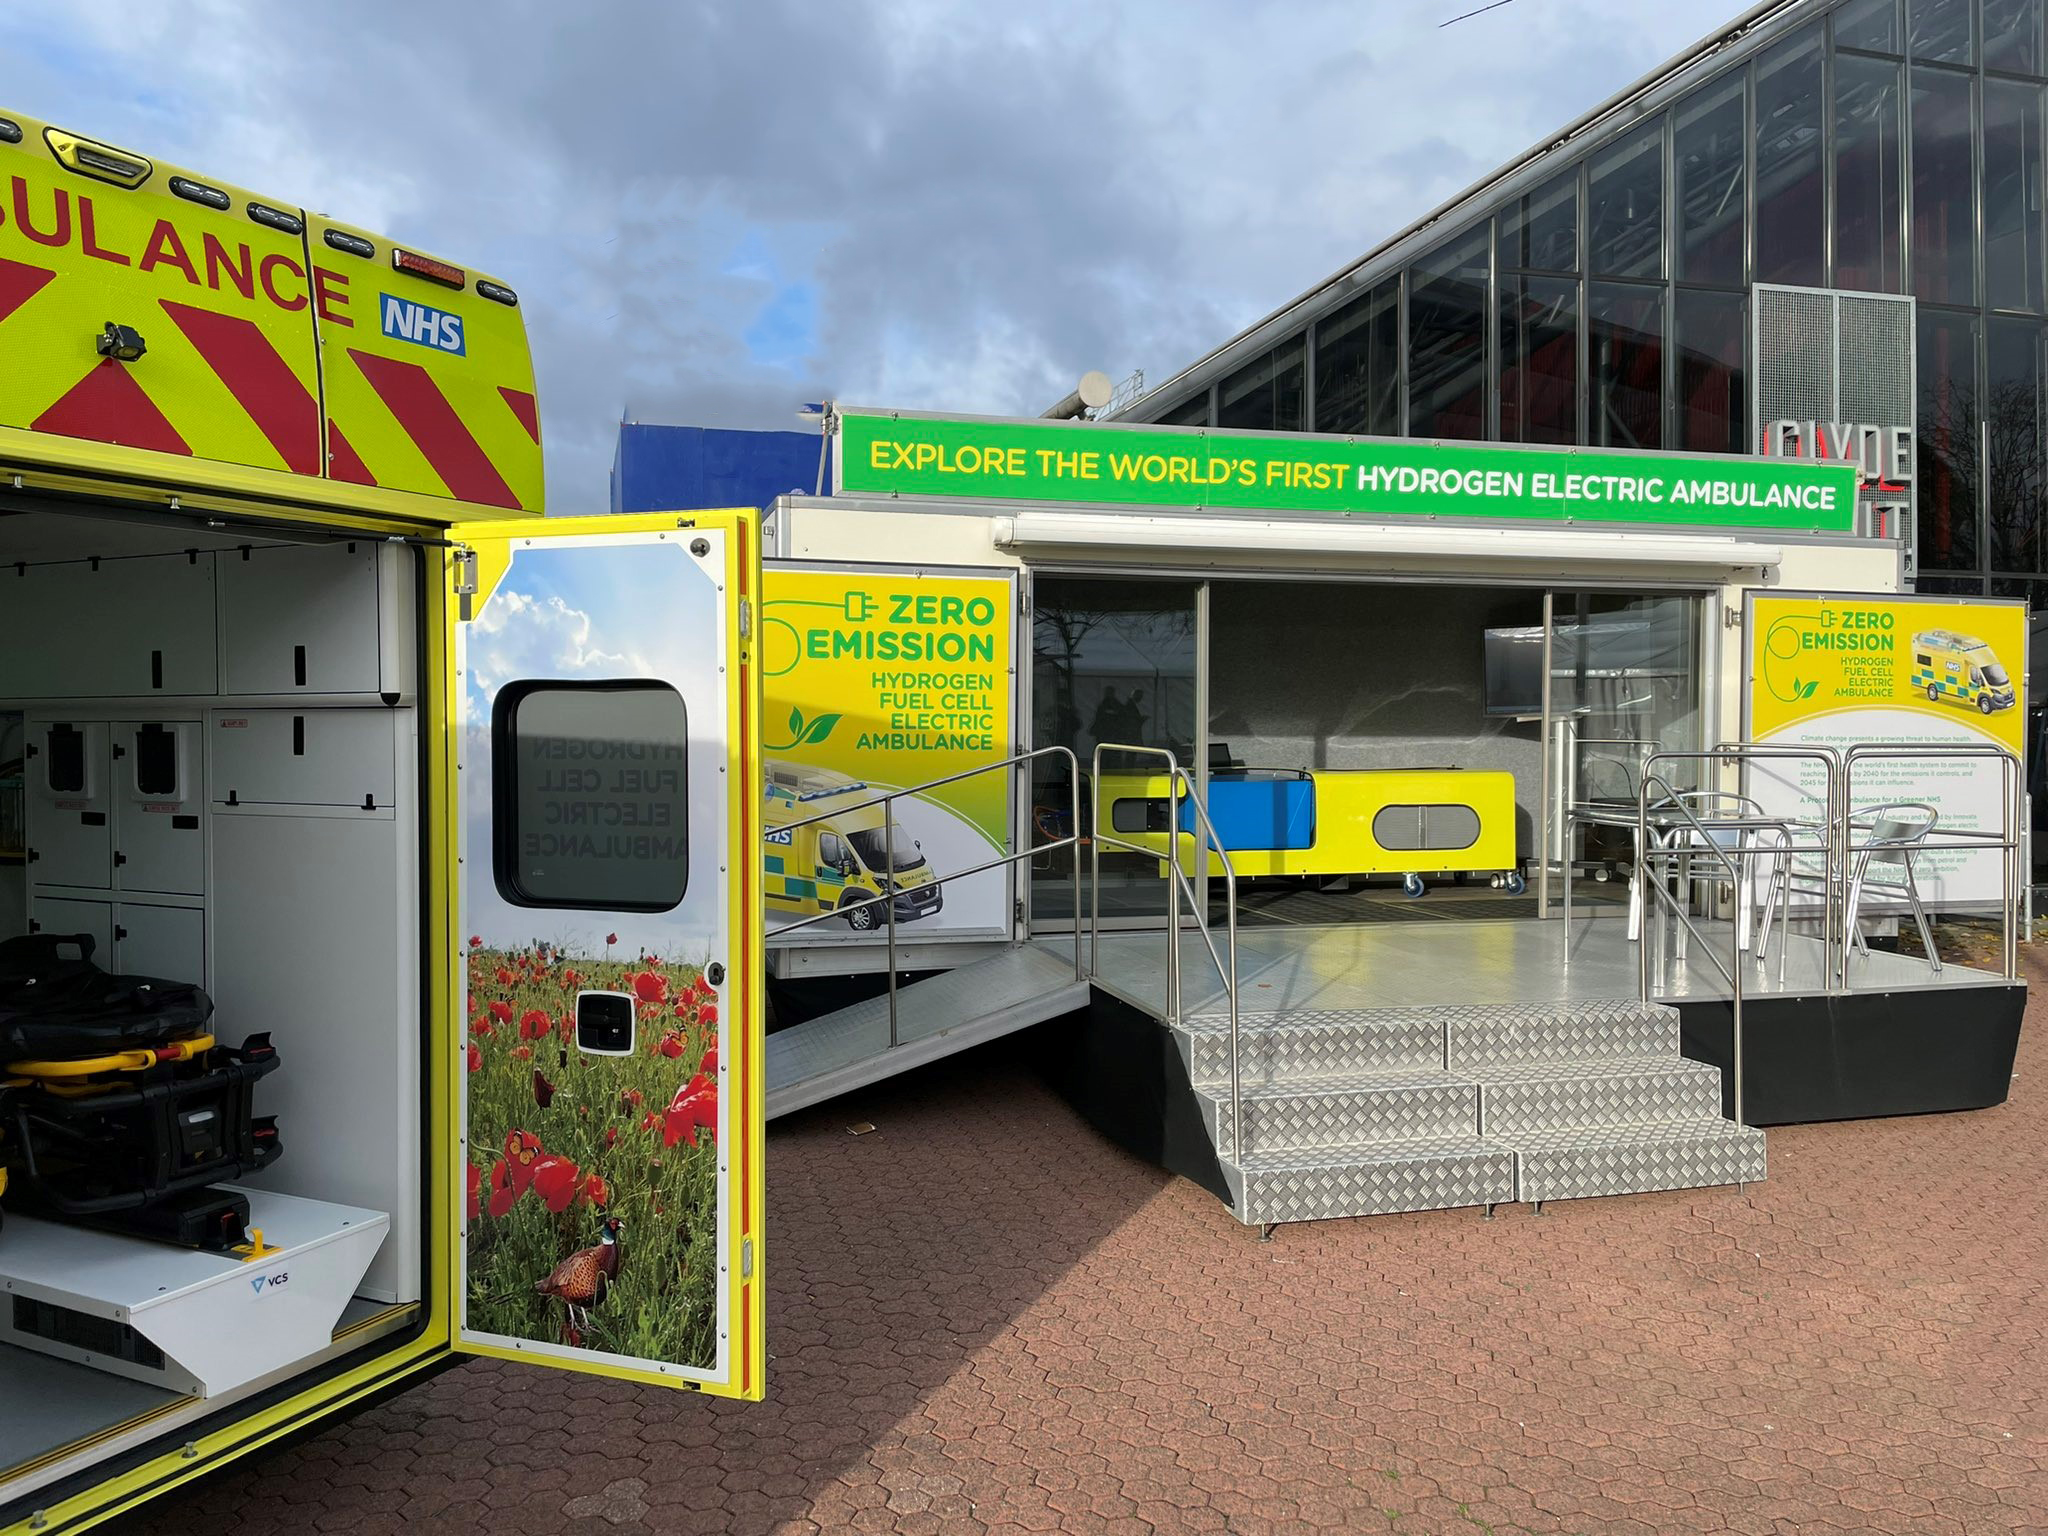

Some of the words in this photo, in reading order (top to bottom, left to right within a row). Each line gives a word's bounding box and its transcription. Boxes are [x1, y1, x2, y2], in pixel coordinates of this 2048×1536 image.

[0, 176, 354, 328] ULANCE
[385, 298, 460, 350] NHS
[871, 441, 1026, 476] EXPLORE
[1036, 450, 1099, 478] THE
[1267, 462, 1350, 489] FIRST
[1358, 465, 1523, 497] HYDROGEN
[1531, 473, 1663, 503] ELECTRIC
[1670, 480, 1836, 511] AMBULANCE
[889, 595, 995, 626] ZERO
[1842, 611, 1894, 630] ZERO
[807, 630, 993, 662] EMISSION
[1802, 633, 1894, 651] EMISSION
[1841, 657, 1893, 666] HYDROGEN
[1844, 667, 1868, 676] FUEL
[1870, 668, 1894, 677] CELL
[872, 672, 993, 690] HYDROGEN
[1849, 677, 1894, 687] ELECTRIC
[1834, 688, 1893, 697] AMBULANCE
[880, 693, 934, 709] FUEL
[941, 694, 993, 710] CELL
[892, 713, 993, 730] ELECTRIC
[857, 733, 993, 750] AMBULANCE
[1801, 734, 1824, 742] Climate
[1825, 734, 1847, 743] change
[1848, 735, 1874, 743] presents
[1880, 735, 1904, 743] growing
[1800, 770, 1826, 778] reaching
[1886, 761, 1899, 769] first
[1919, 762, 1940, 770] system
[268, 1273, 288, 1287] VCS
